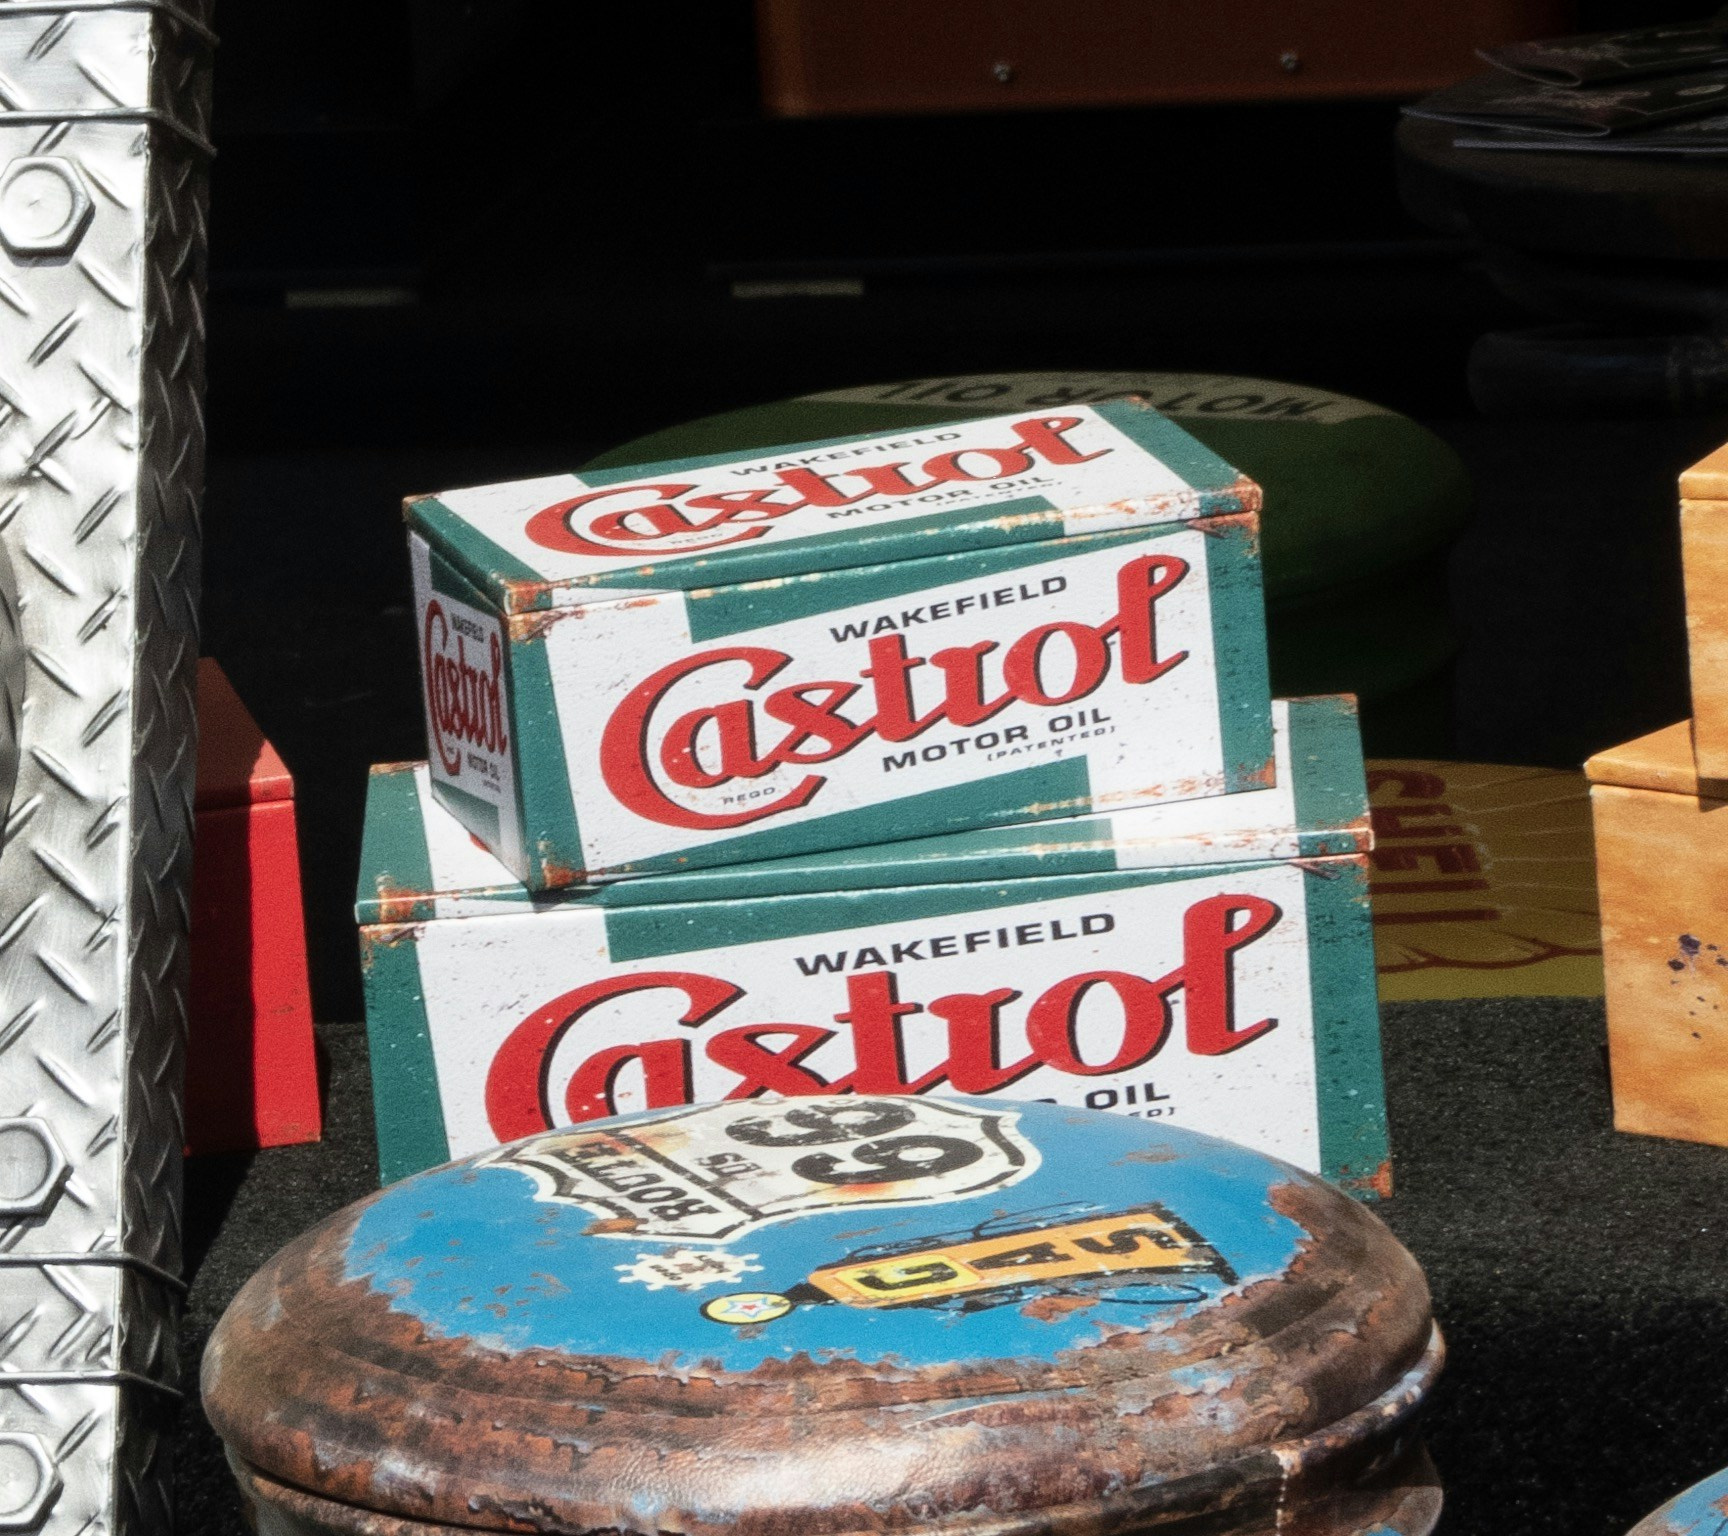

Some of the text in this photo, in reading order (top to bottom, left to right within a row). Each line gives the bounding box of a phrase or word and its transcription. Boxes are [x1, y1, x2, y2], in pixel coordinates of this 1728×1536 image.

[524, 415, 1114, 557] Castrol
[730, 431, 963, 477] WAKEFIELD
[826, 475, 1056, 520] MOTOR OIL
[829, 574, 1068, 644] WAKEFIELD
[424, 598, 508, 777] Castrol
[599, 553, 1191, 831] Castrol
[881, 706, 1113, 773] MOTOR OIL
[986, 723, 1117, 763] (PATENTED)
[793, 912, 1117, 977] WAKEFIELD
[485, 893, 1284, 1144] Castrol
[1085, 1082, 1171, 1111] OIL
[560, 1144, 716, 1226] ROUTE
[855, 1227, 1177, 1292] GAS
